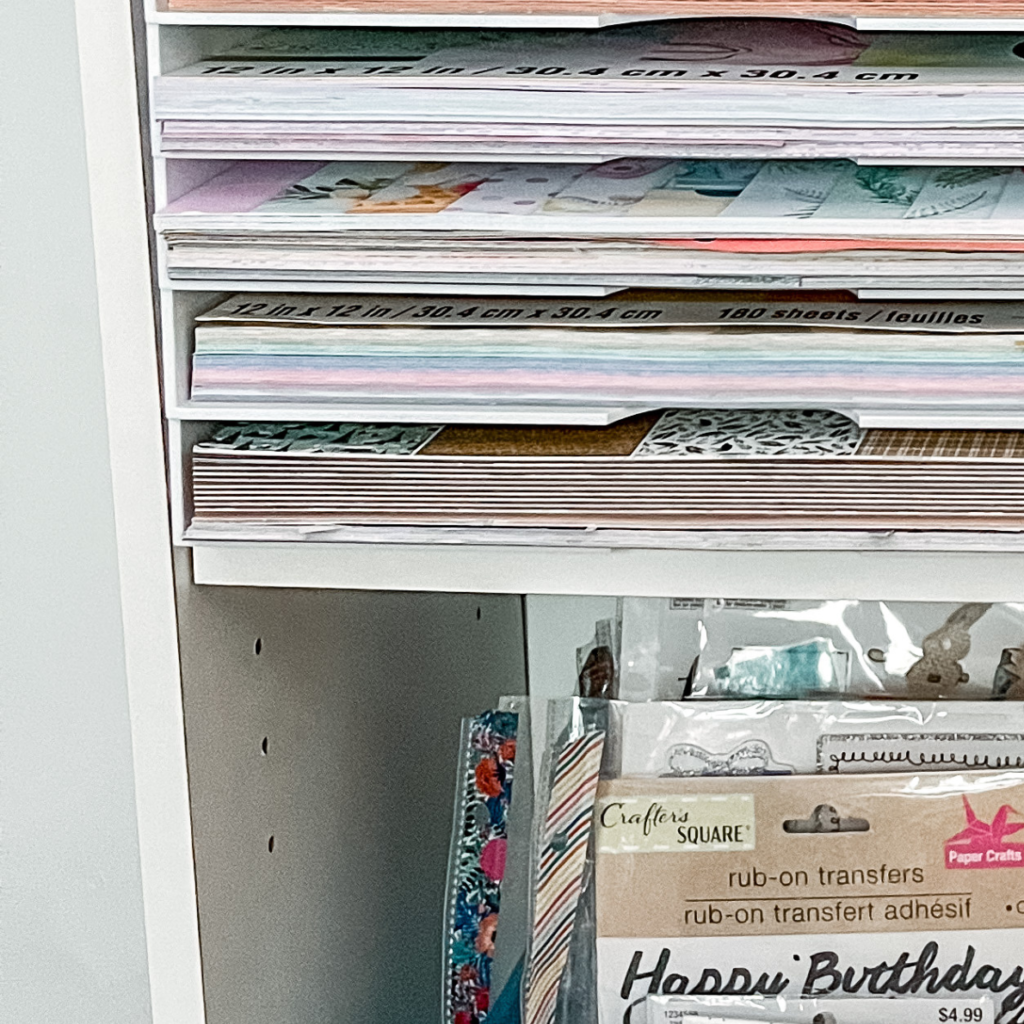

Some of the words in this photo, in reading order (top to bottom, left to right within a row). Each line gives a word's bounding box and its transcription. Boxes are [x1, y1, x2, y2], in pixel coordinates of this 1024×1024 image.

[201, 65, 255, 75] 12
[314, 66, 347, 75] x
[362, 65, 414, 75] 12
[505, 66, 610, 77] 30.4
[620, 68, 688, 78] cm
[700, 69, 729, 78] x
[739, 69, 841, 81] 30.4
[854, 71, 920, 81] cm
[230, 302, 268, 316] 12
[266, 302, 298, 317] in
[297, 305, 321, 317] x
[326, 304, 362, 318] 12
[361, 304, 393, 318] in
[389, 304, 418, 320] /
[412, 305, 480, 318] 30.4
[480, 308, 525, 319] cm
[525, 308, 550, 319] x
[551, 306, 618, 319] 30.4
[619, 309, 664, 320] cm
[718, 307, 767, 319] 180
[770, 307, 862, 322] sheets
[865, 308, 884, 323] /
[885, 309, 986, 325] feuilles
[600, 801, 690, 837] Crafter's
[676, 824, 745, 845] SQUARE
[948, 849, 984, 866] Paper
[985, 848, 1023, 864] Crafts
[728, 866, 809, 888] rub-on
[819, 863, 925, 887] transfers
[684, 903, 764, 925] rub-on
[773, 900, 875, 923] transfert
[884, 897, 972, 921] adhésif
[937, 1007, 984, 1024] $4.99
